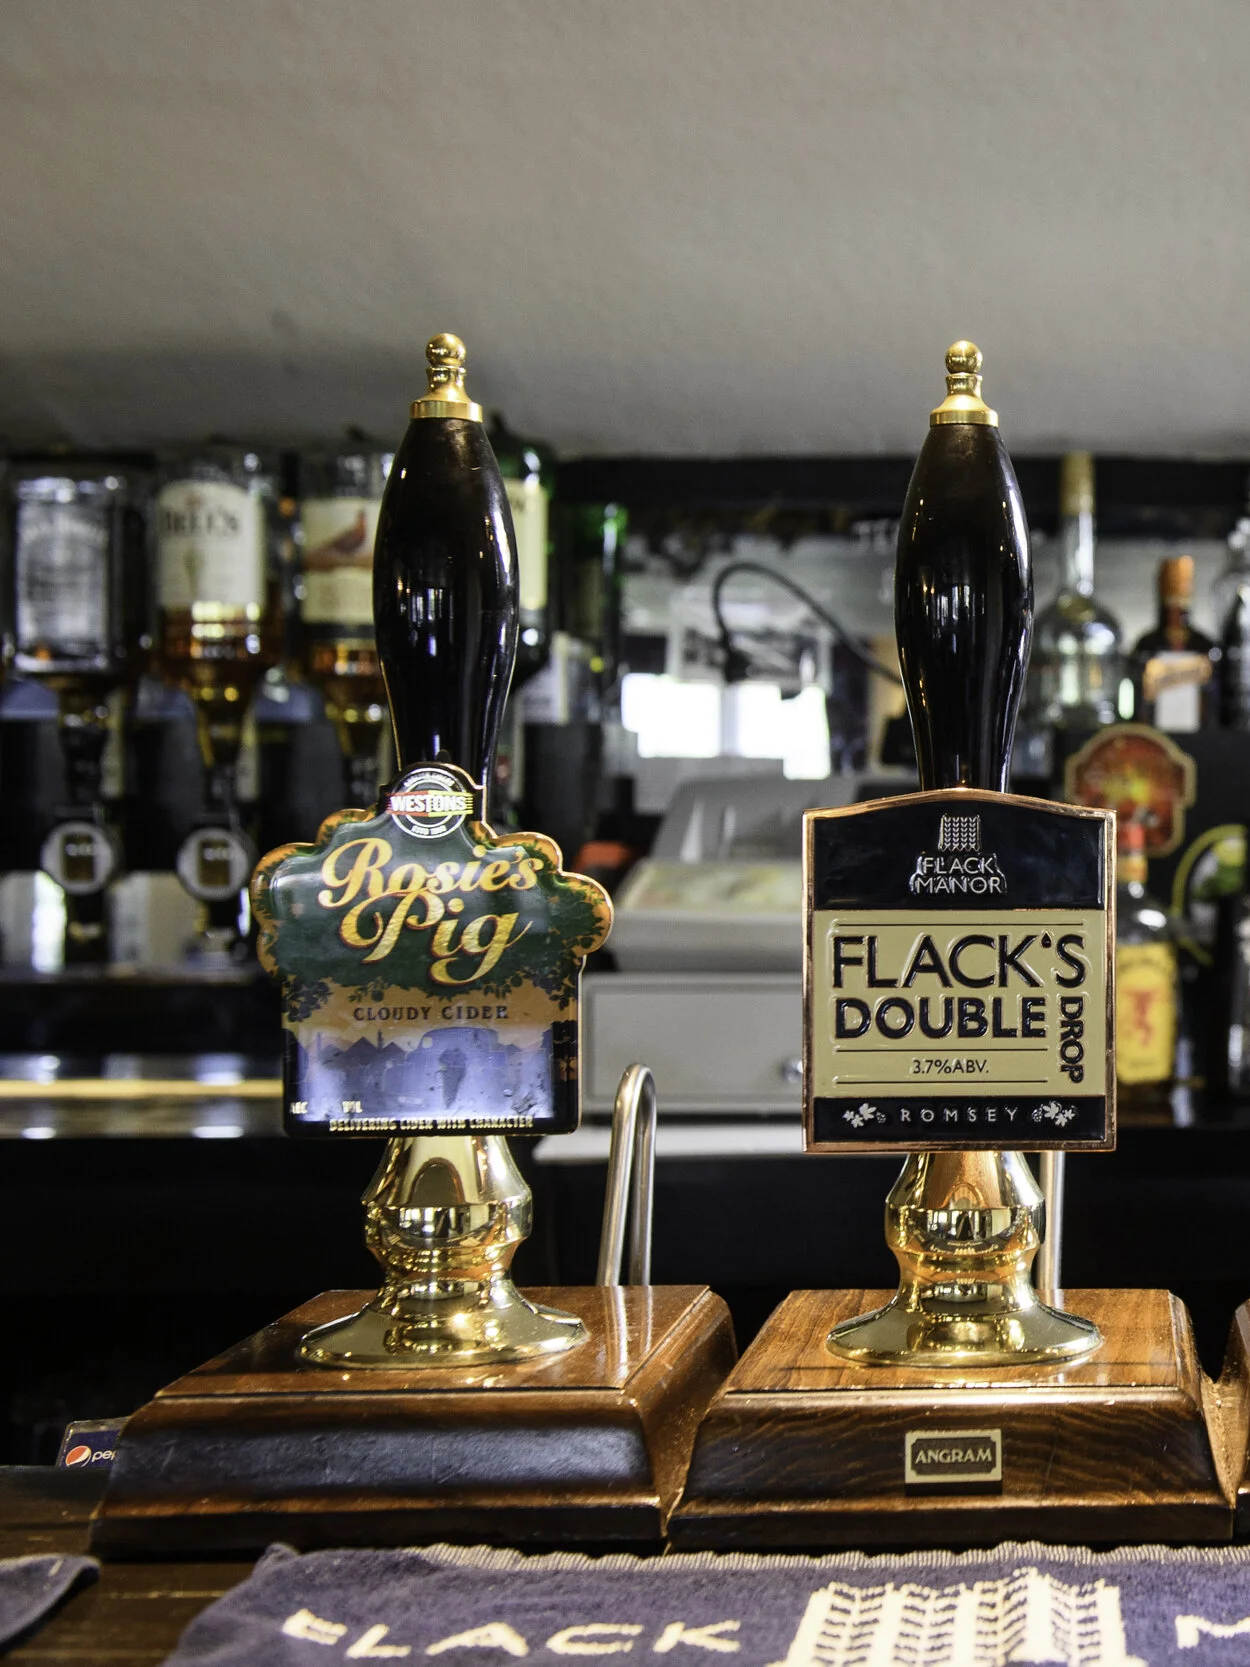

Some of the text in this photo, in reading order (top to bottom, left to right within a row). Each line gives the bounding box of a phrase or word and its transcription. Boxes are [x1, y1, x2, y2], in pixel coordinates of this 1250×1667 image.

[389, 794, 467, 812] WESTONS
[318, 837, 545, 909] Rosie's
[923, 857, 995, 875] FLACK
[916, 877, 1003, 894] MANOR
[339, 888, 534, 985] Pig
[833, 931, 1086, 989] FLACK'S
[353, 1004, 508, 1021] CLOUDY CIDER
[834, 997, 1047, 1040] DOUBLE
[1060, 997, 1085, 1084] DROP
[329, 1118, 397, 1132] DELIVERING
[400, 1118, 434, 1130] CIDER
[469, 1115, 534, 1129] CHARACTER
[901, 1107, 1018, 1122] ROMSEY
[914, 1448, 992, 1464] ANGRAM
[281, 1607, 741, 1660] FLACK
